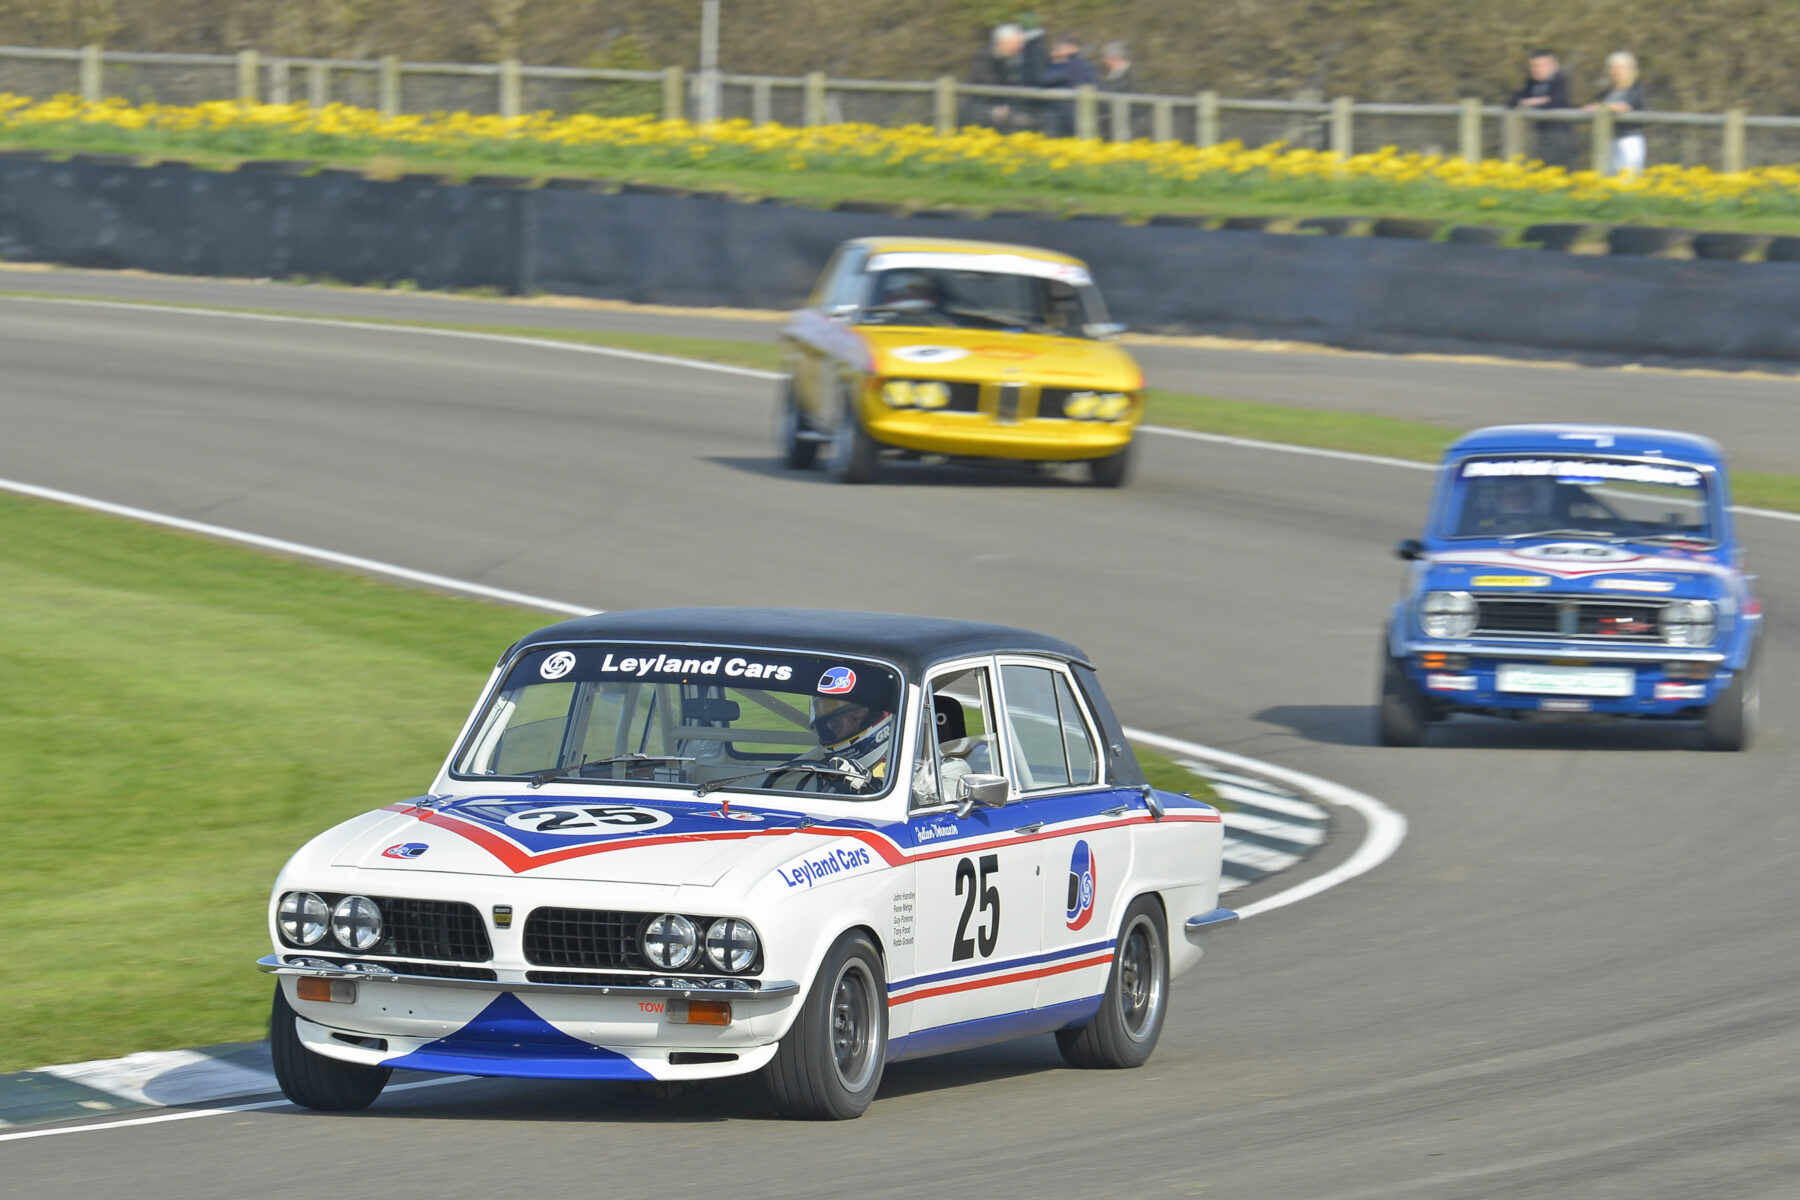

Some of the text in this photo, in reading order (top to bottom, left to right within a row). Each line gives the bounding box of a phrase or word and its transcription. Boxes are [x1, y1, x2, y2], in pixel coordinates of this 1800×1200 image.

[601, 653, 793, 681] Leyland Cars
[517, 806, 658, 832] 25
[776, 847, 870, 888] Leyland Cars
[951, 853, 1000, 962] 25
[638, 1002, 665, 1013] TOW
